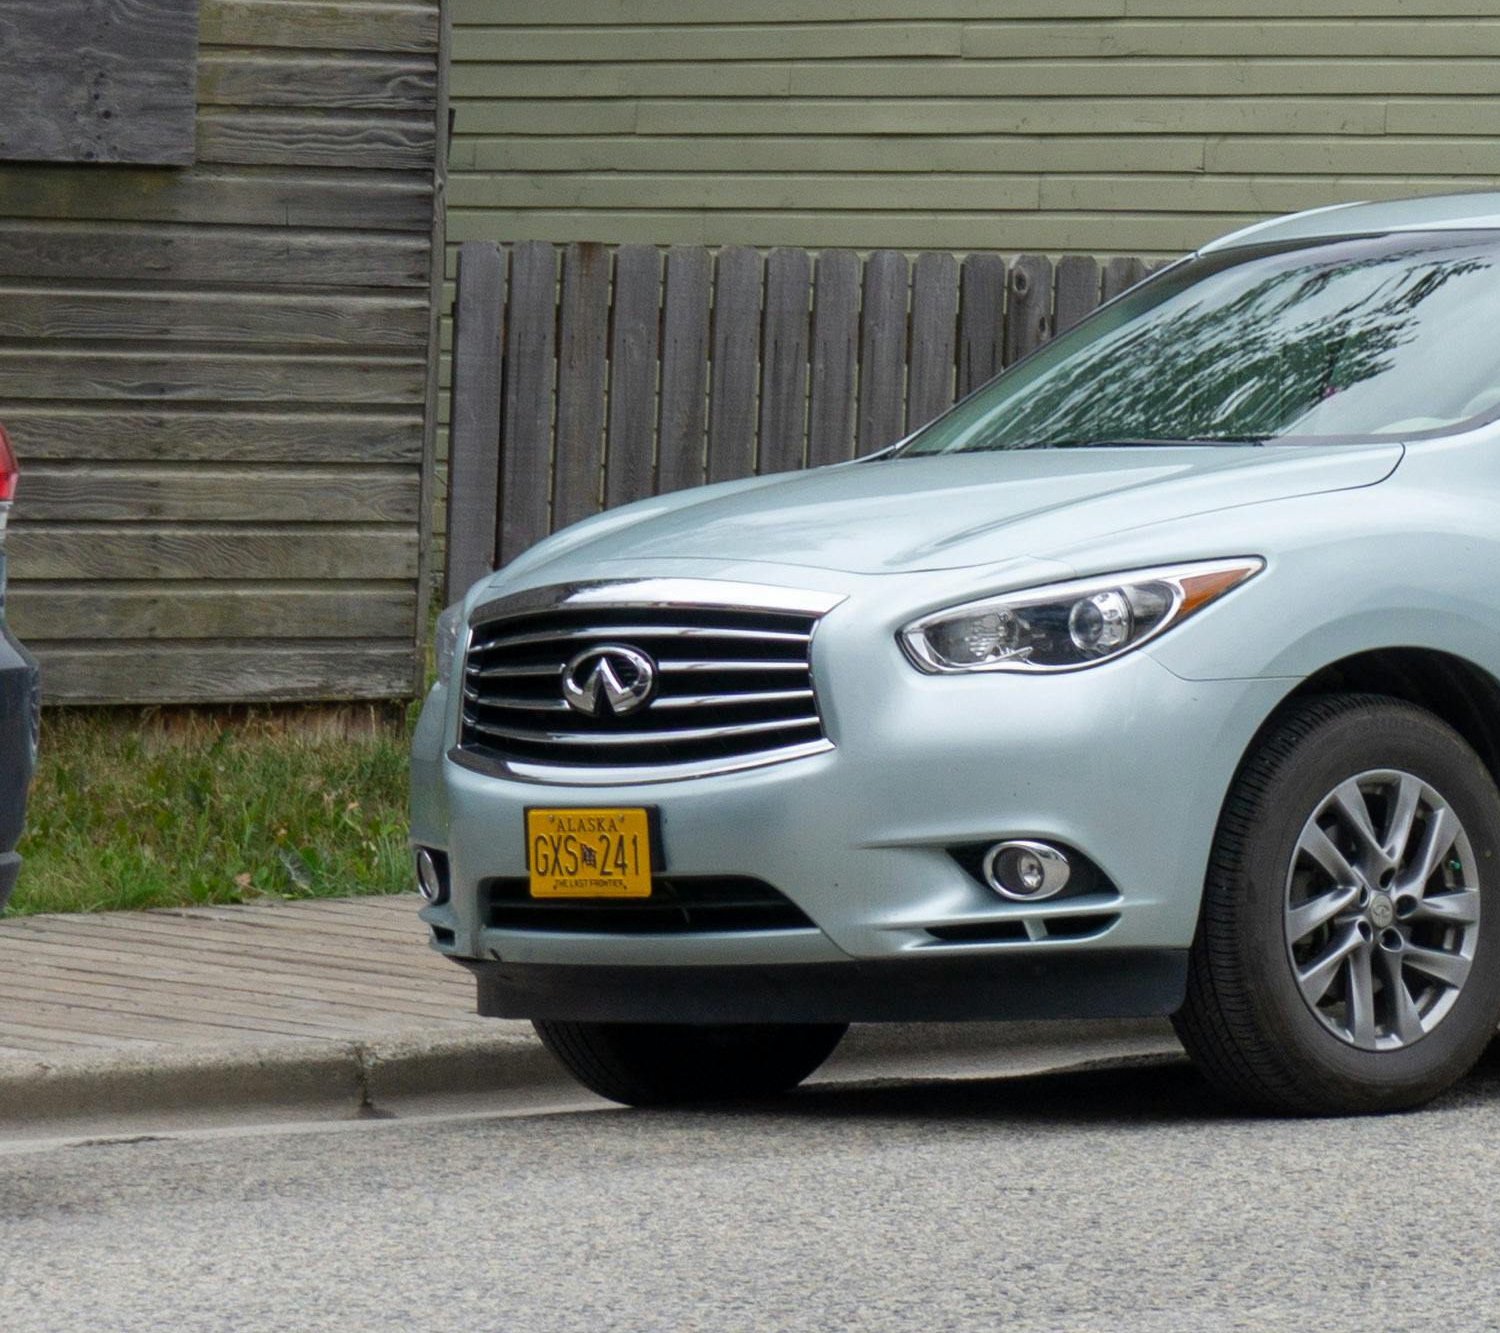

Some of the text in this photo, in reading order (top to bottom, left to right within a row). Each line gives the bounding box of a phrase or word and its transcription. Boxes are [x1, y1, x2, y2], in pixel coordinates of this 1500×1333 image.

[557, 817, 618, 833] ALASKA
[535, 833, 640, 876] GXS 241
